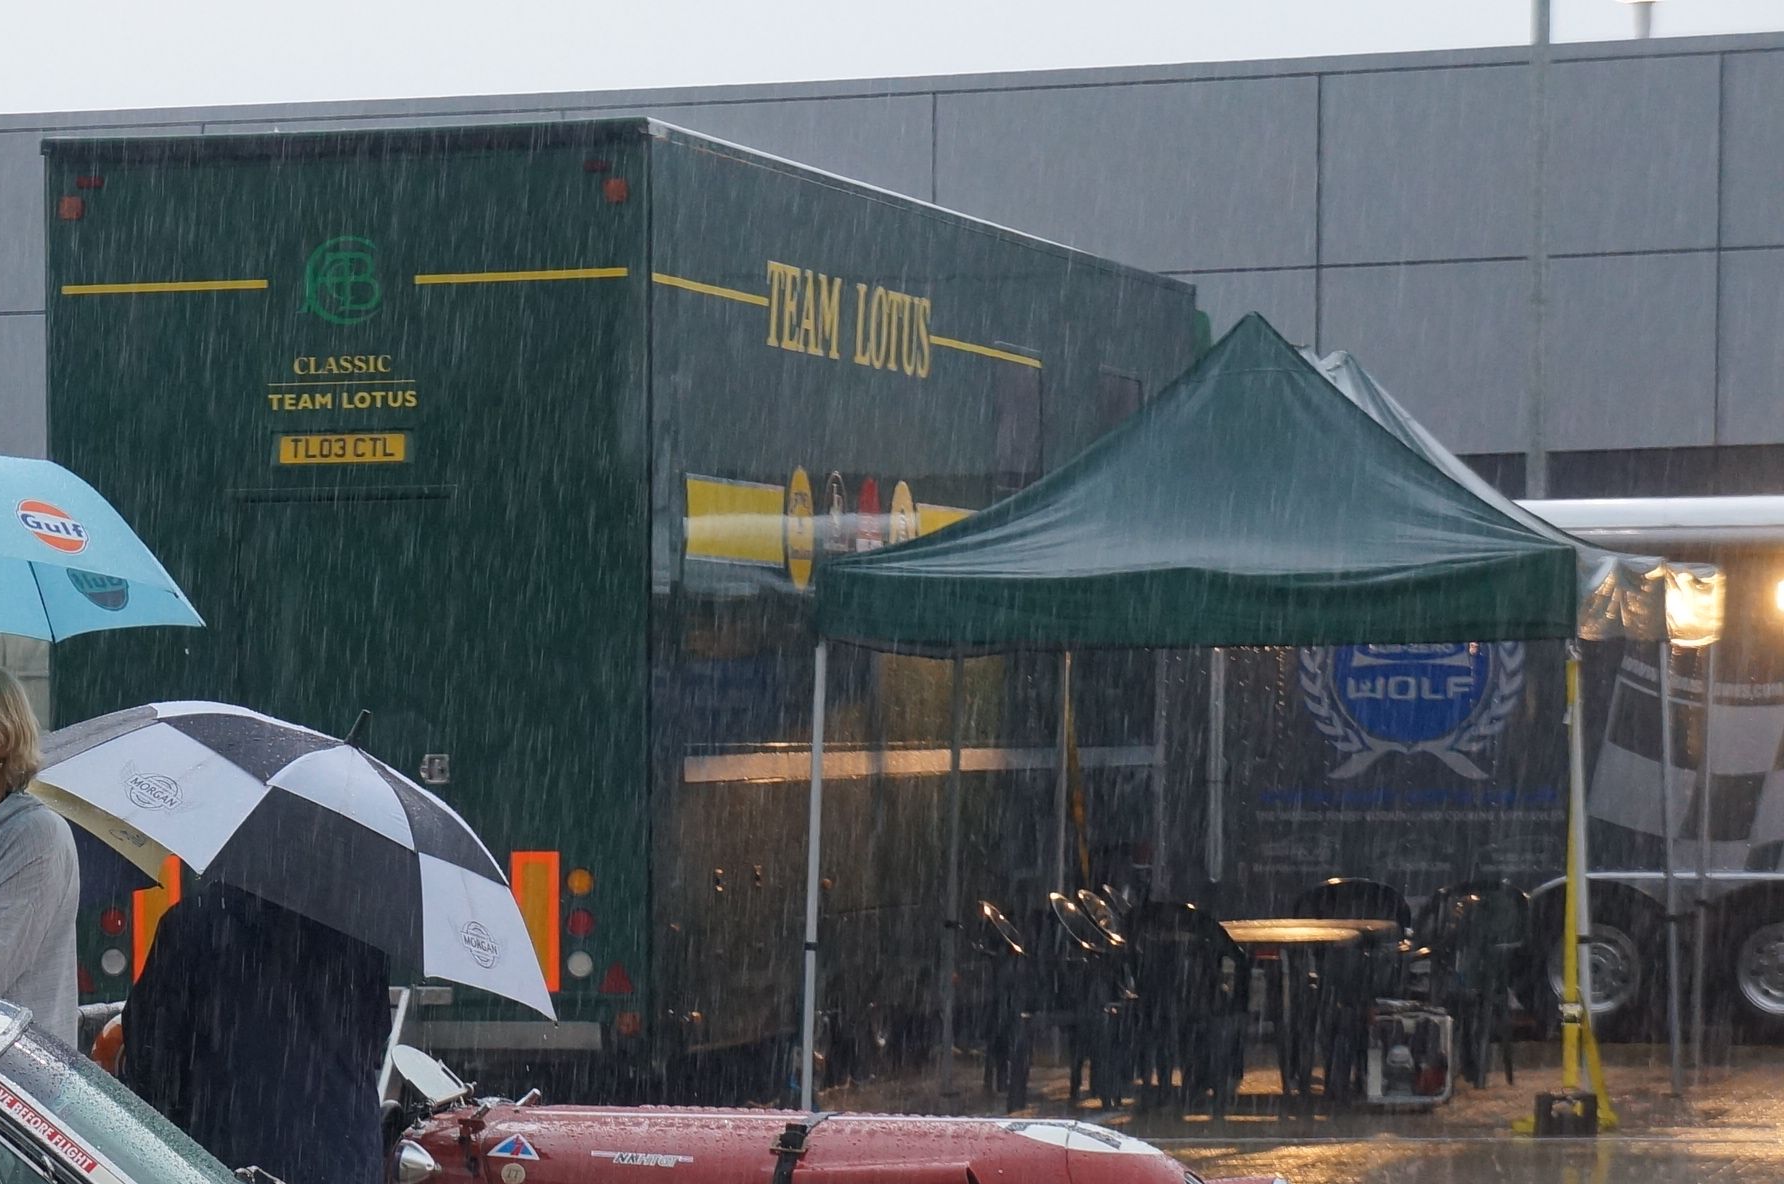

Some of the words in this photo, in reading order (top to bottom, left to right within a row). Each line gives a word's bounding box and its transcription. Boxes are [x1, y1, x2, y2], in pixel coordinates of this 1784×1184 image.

[767, 260, 842, 360] TEAM
[854, 283, 931, 378] LOTUS
[293, 355, 392, 375] CLASSIC
[268, 392, 332, 411] TEAM
[342, 391, 417, 409] LOTUS
[291, 438, 347, 458] TL03
[353, 437, 395, 457] CTL
[20, 512, 85, 538] Gulf
[1347, 676, 1474, 700] WOLF
[130, 777, 177, 807] MORGAN
[463, 934, 498, 955] MORGAN
[10, 1101, 55, 1138] BEFORE
[51, 1135, 94, 1170] FLIGHT
